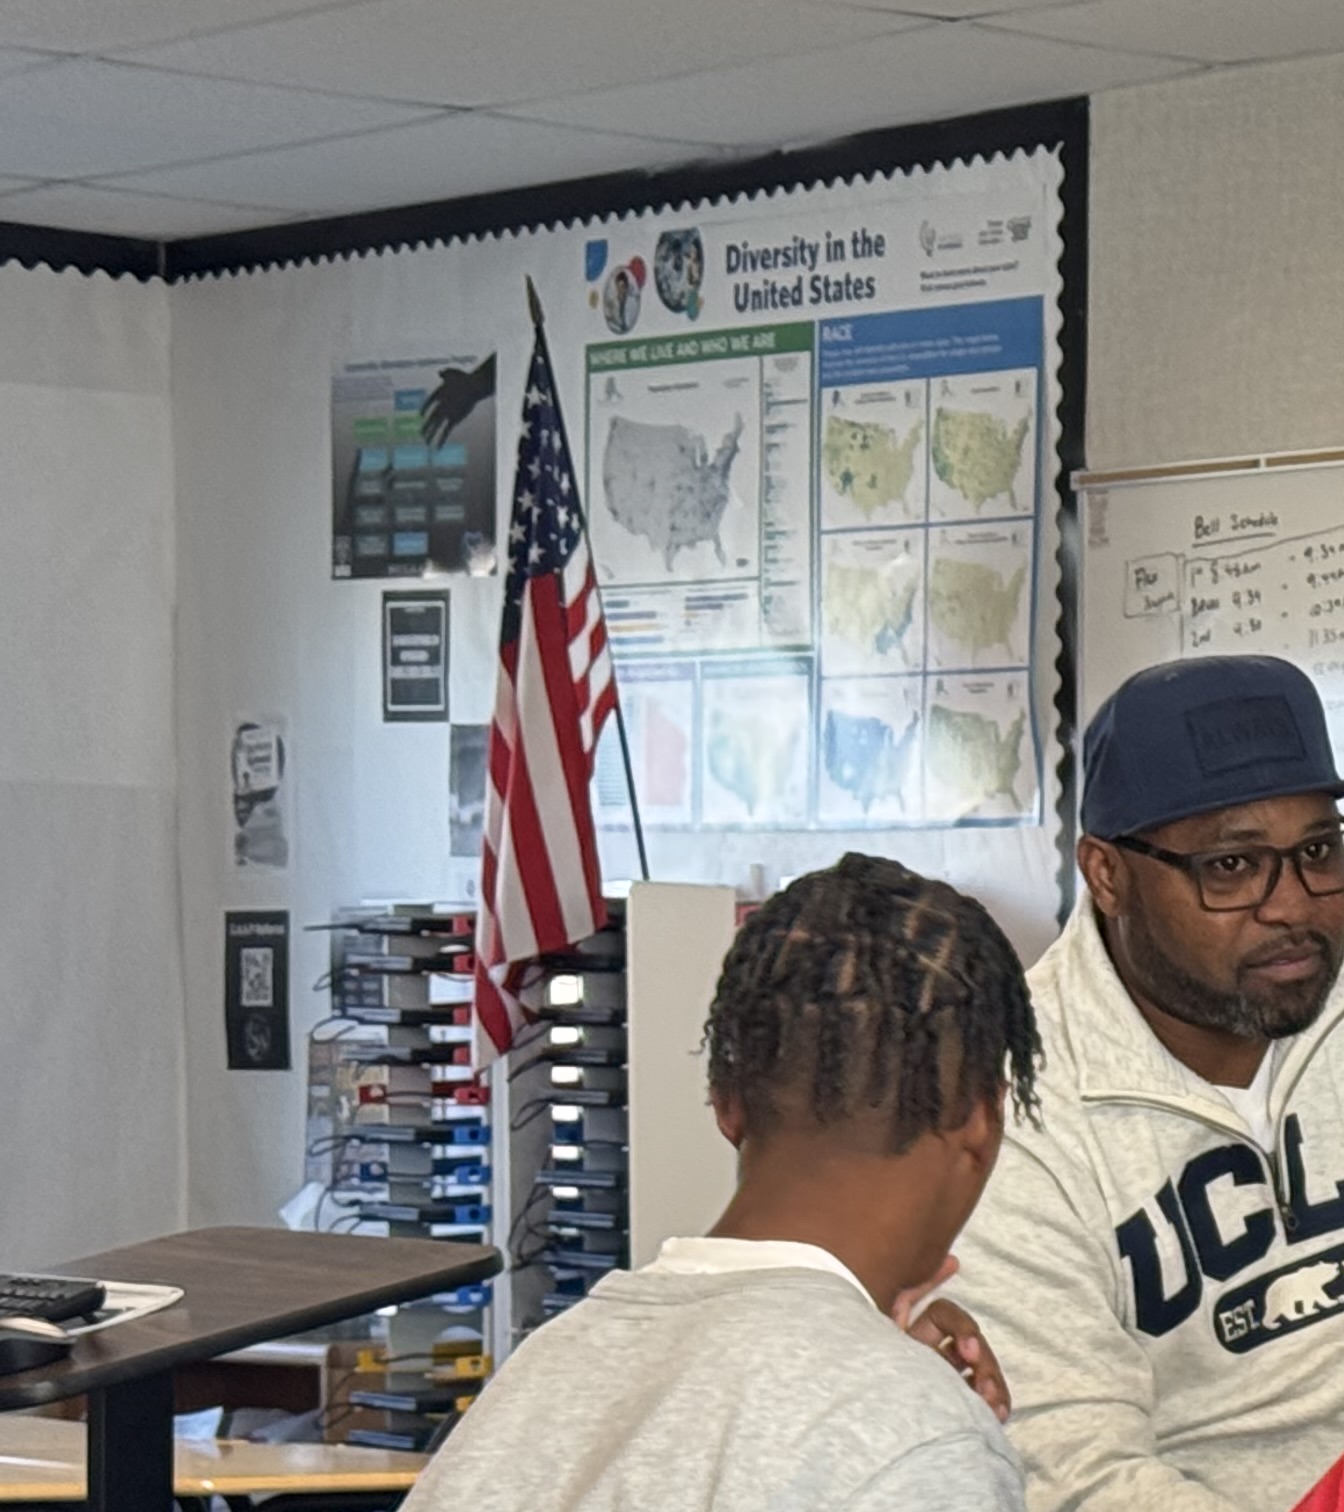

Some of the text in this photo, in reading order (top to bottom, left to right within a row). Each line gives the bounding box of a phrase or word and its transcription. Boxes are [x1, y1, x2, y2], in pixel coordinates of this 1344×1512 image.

[726, 227, 886, 274] Diversity in the
[734, 272, 876, 312] United States
[629, 347, 648, 362] WE
[676, 340, 699, 357] AND
[701, 336, 729, 353] WHO
[729, 334, 750, 350] WE
[753, 332, 776, 348] ARE
